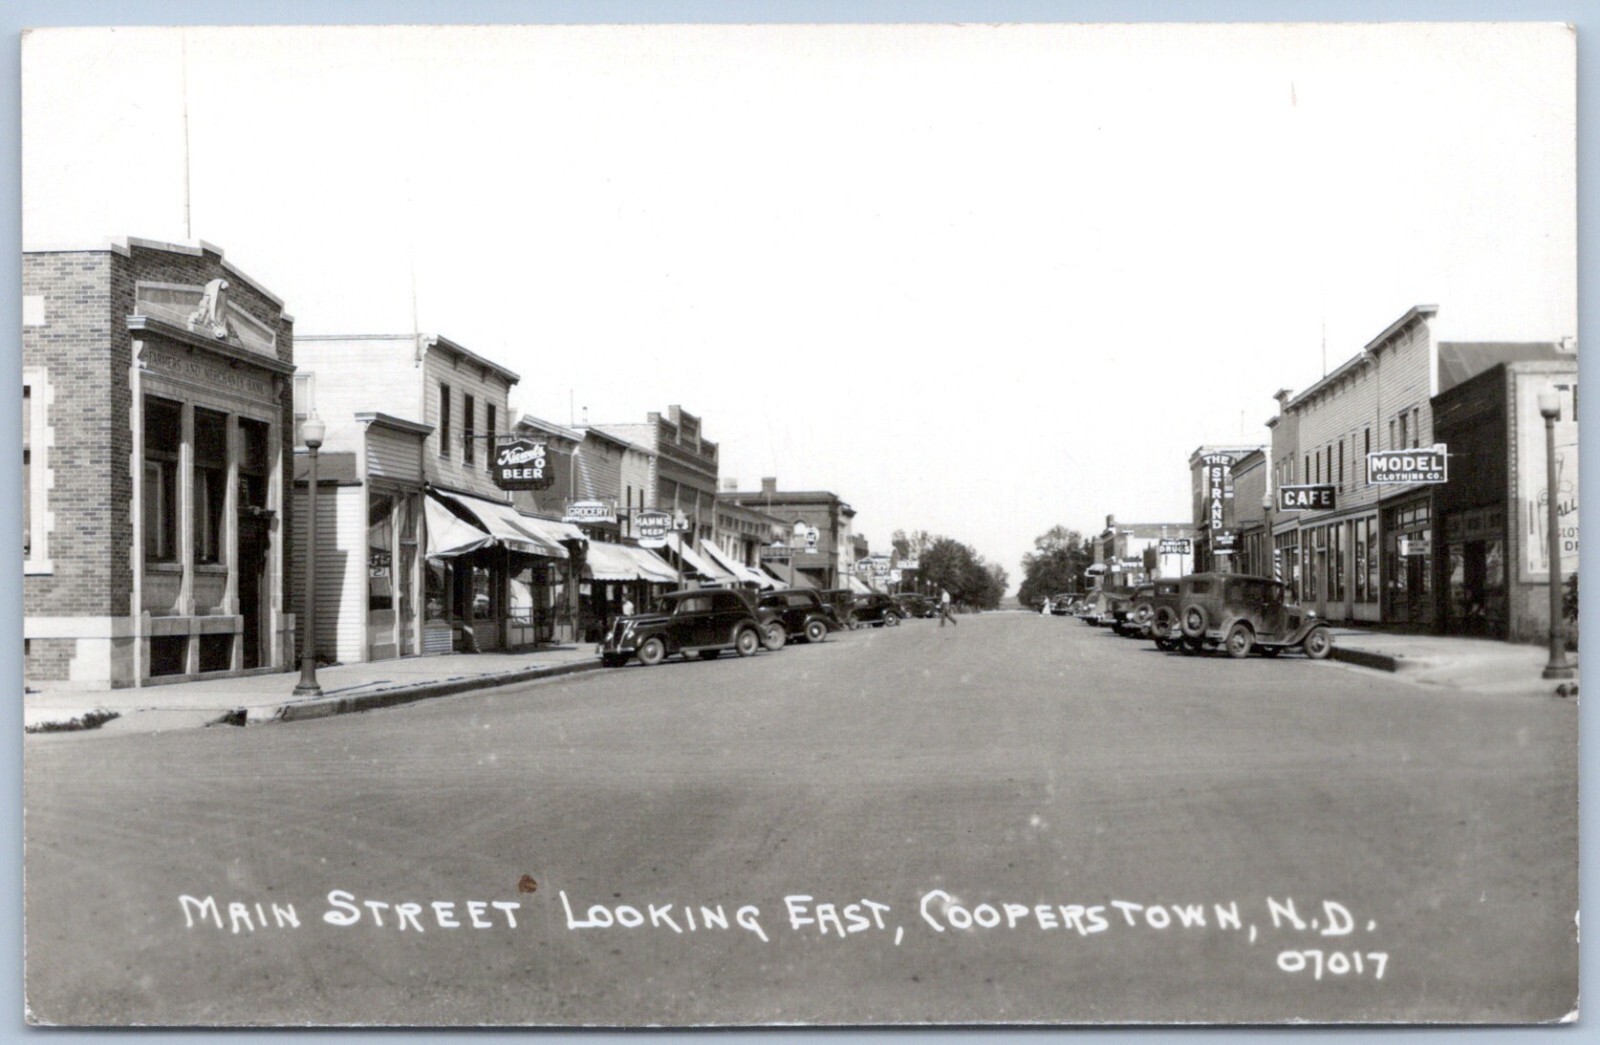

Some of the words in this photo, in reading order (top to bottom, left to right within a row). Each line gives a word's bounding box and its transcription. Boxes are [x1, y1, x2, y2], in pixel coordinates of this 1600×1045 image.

[1202, 455, 1230, 465] THE
[1372, 456, 1443, 471] MODEL
[502, 468, 543, 479] BEER
[1376, 472, 1424, 480] CLOTHING
[1426, 472, 1444, 480] CO.
[1211, 467, 1223, 529] STRAND
[1284, 490, 1331, 506] CAFE
[568, 507, 609, 517] GROCERY
[1159, 545, 1190, 554] DRUGS
